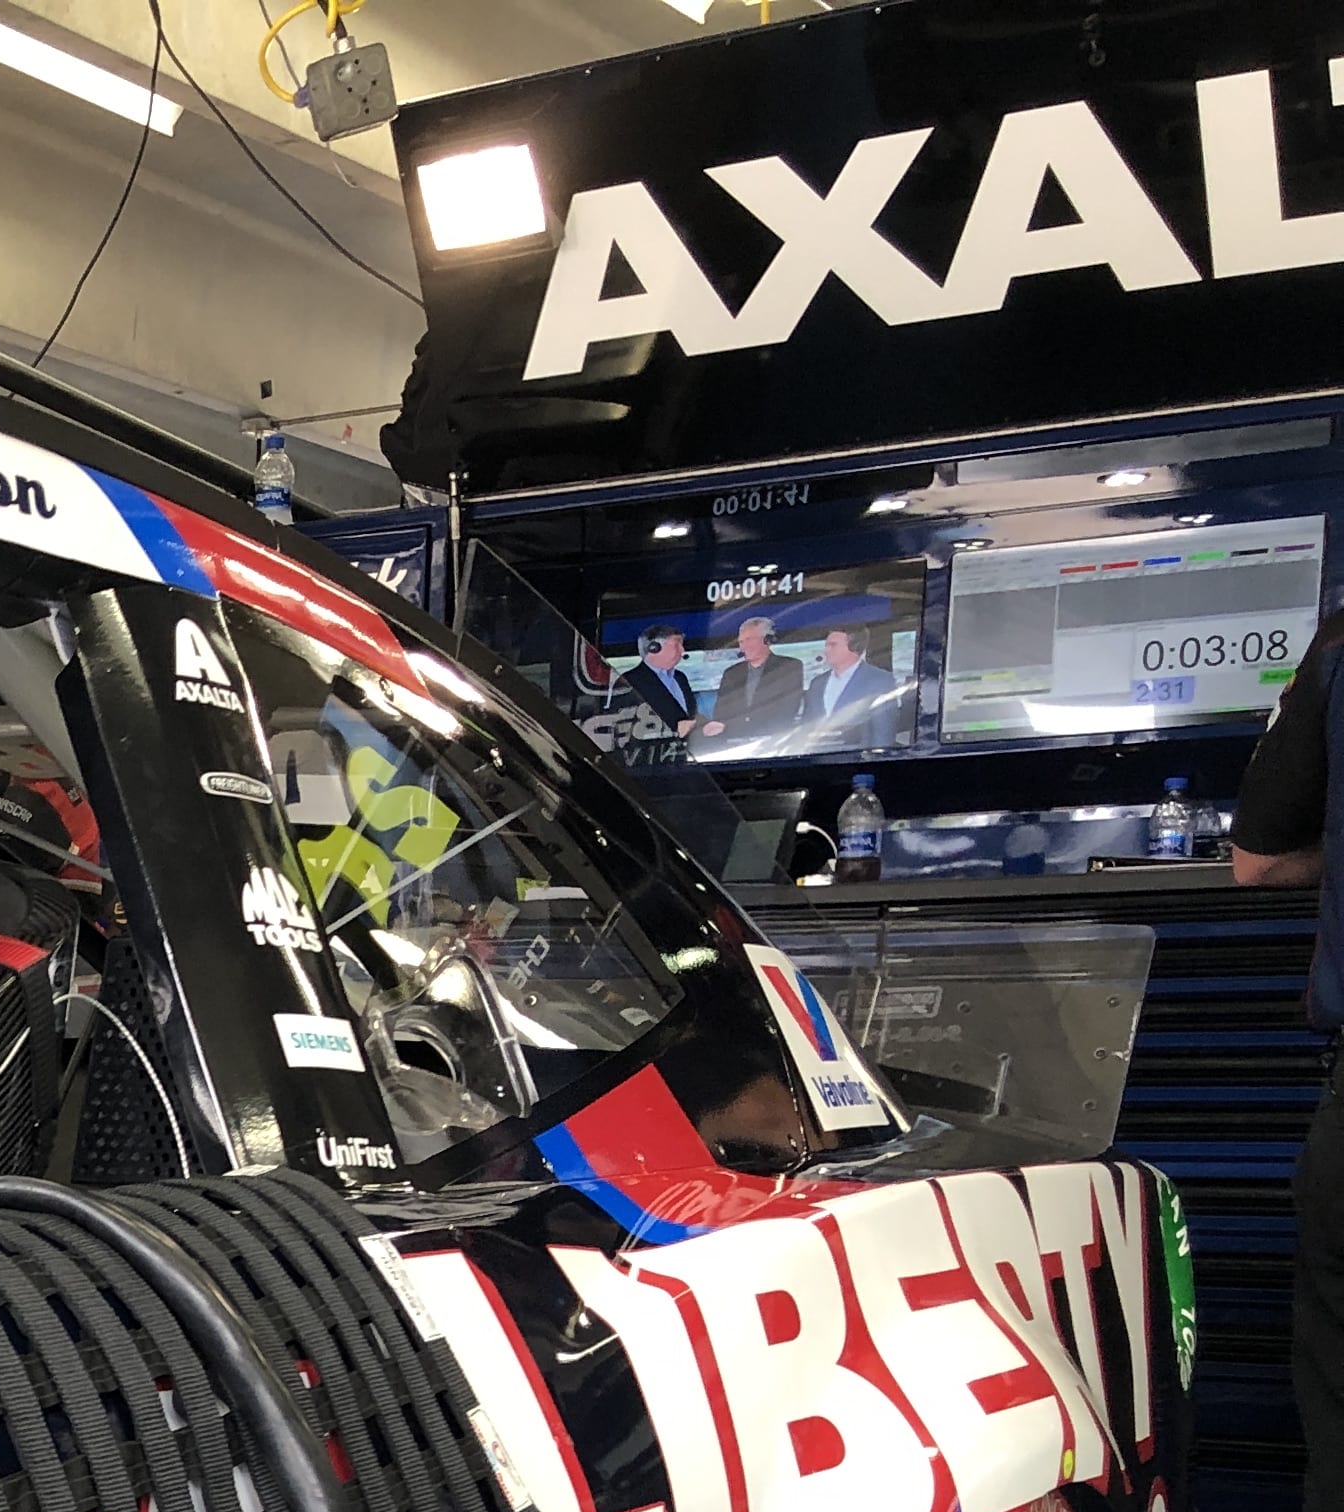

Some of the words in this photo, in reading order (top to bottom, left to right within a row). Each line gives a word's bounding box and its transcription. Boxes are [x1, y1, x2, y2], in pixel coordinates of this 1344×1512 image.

[523, 57, 1344, 381] AXAL
[706, 571, 805, 602] 00:01:41
[1142, 629, 1289, 672] 0:03:08
[175, 680, 246, 714] AXALTA
[242, 866, 316, 931] MAC
[247, 922, 323, 952] TOOLS
[291, 1031, 352, 1053] SIEMENS
[812, 1075, 874, 1108] Valvoline
[316, 1136, 397, 1170] UniFirst
